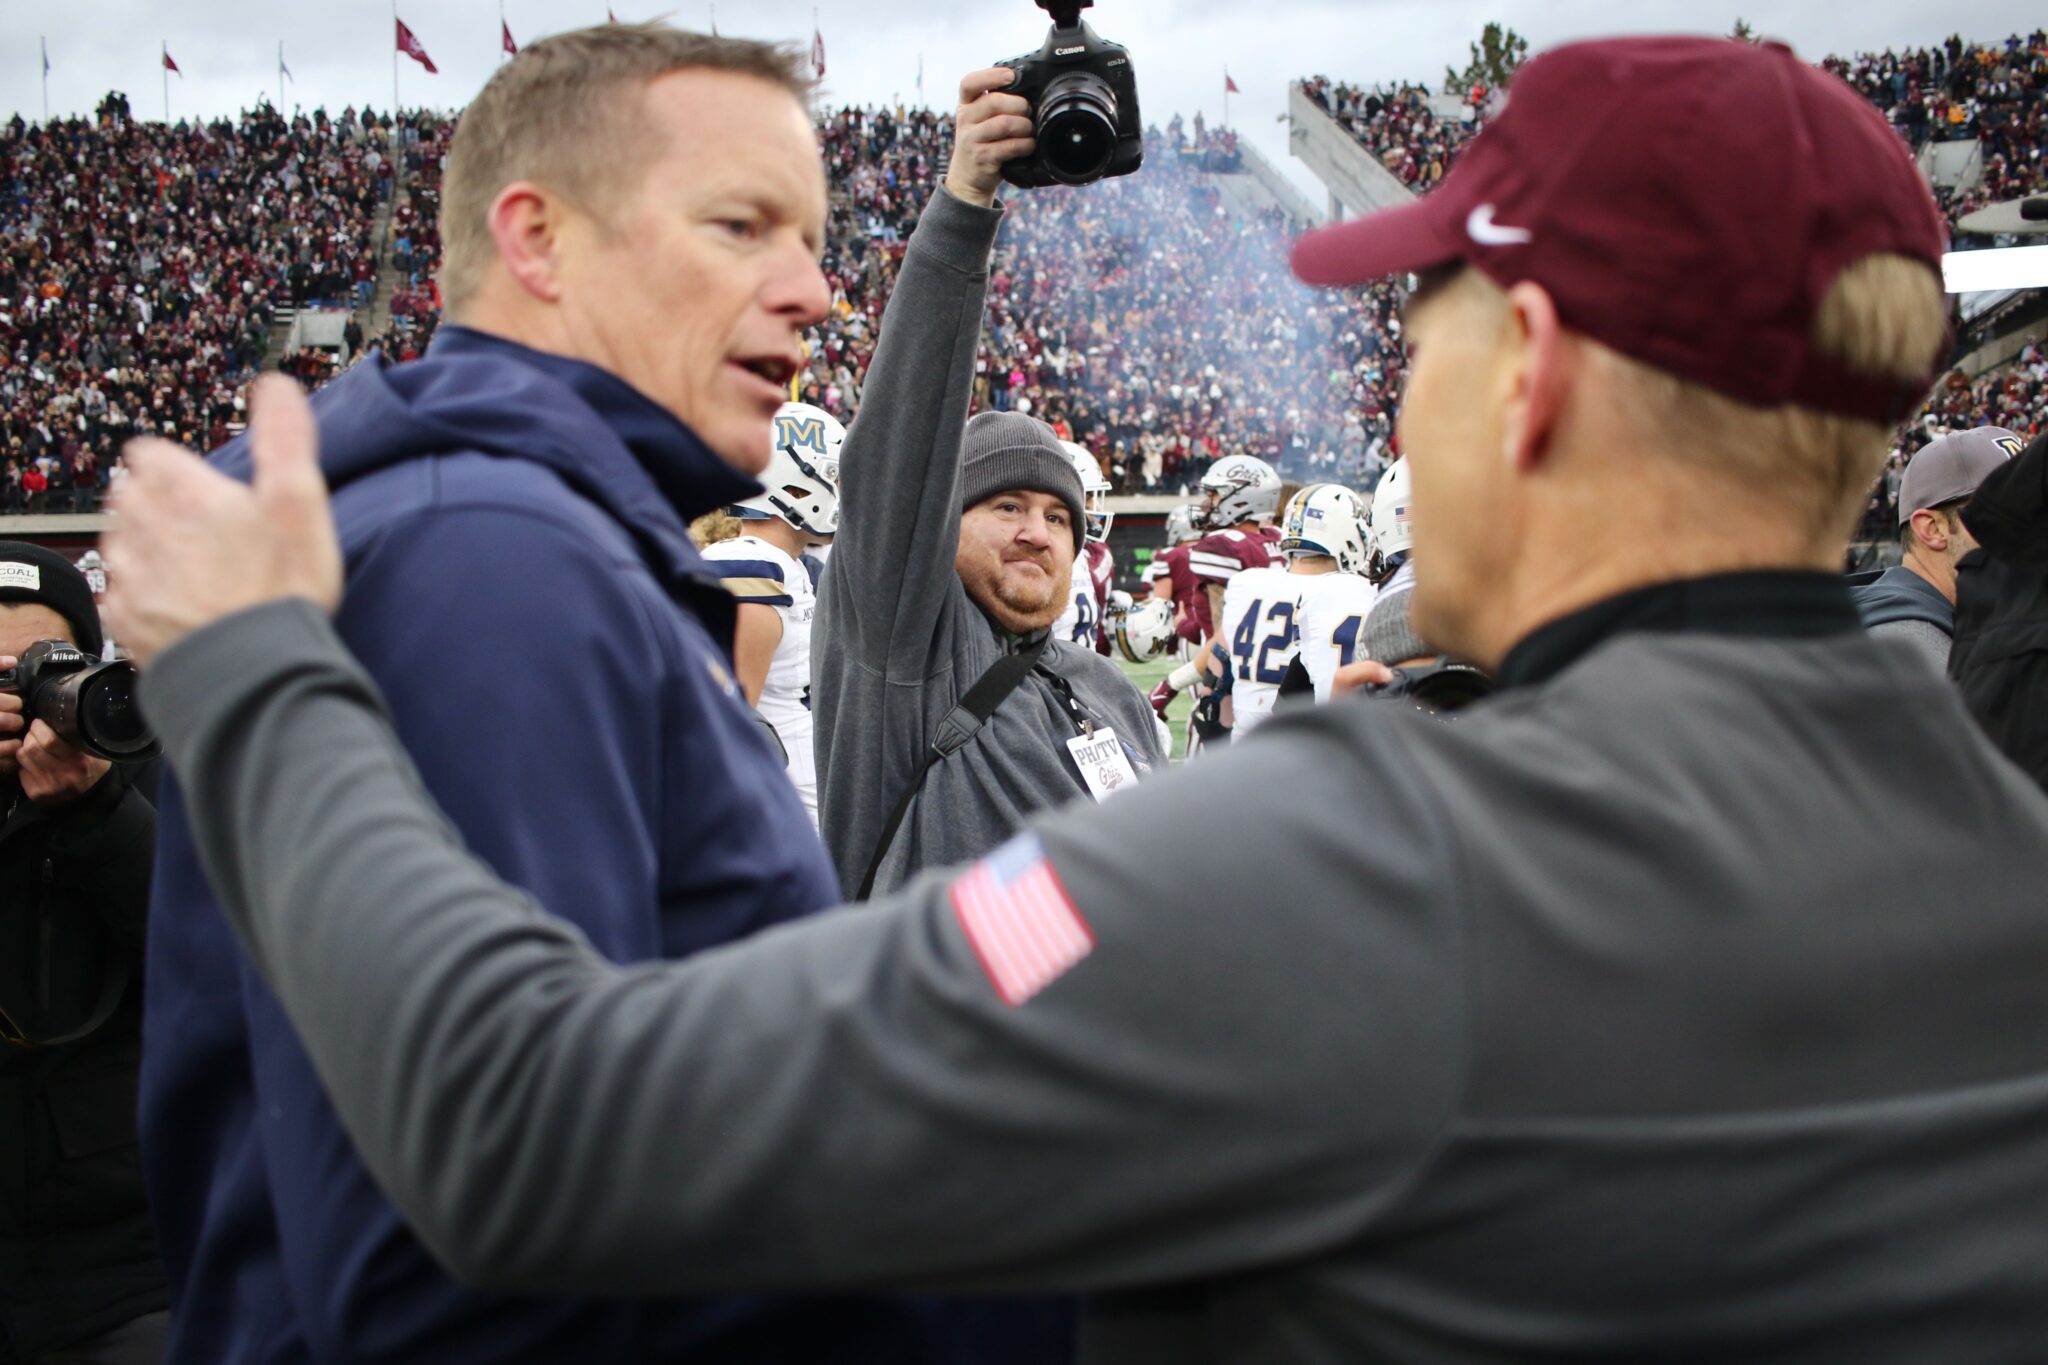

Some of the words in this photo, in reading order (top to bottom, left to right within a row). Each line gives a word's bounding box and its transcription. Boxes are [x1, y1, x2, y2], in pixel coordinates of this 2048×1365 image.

[1055, 45, 1085, 56] Canon
[775, 416, 828, 455] M
[1226, 464, 1261, 487] Griz
[0, 567, 35, 578] COAL
[1232, 598, 1294, 685] 42
[51, 652, 80, 661] Nikon
[1074, 738, 1119, 766] PH/TV
